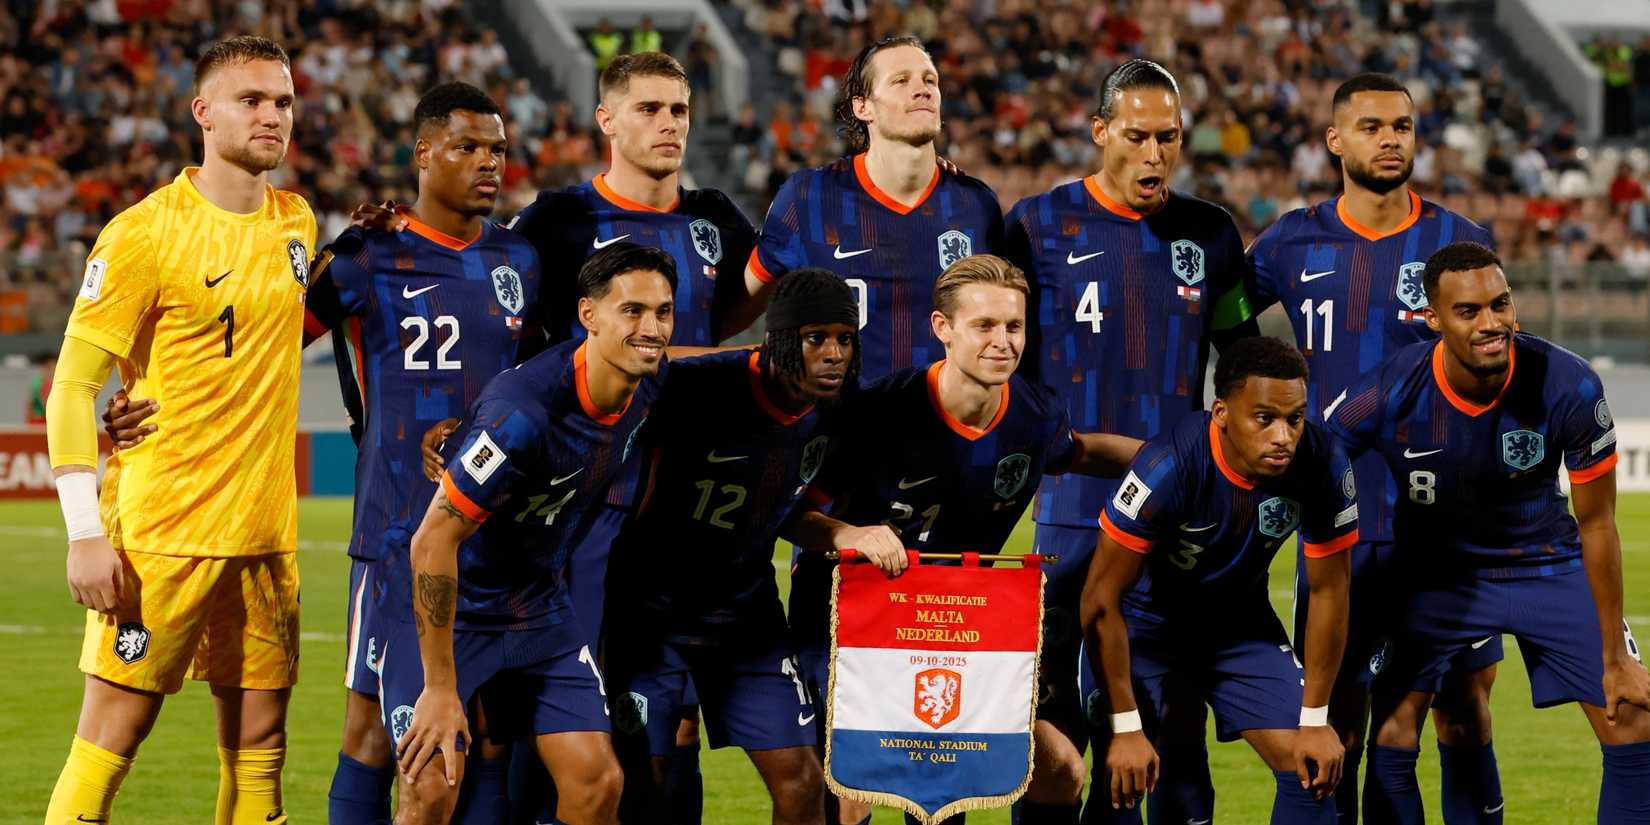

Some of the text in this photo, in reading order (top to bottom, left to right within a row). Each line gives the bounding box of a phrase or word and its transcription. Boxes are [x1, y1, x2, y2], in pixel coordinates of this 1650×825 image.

[1075, 281, 1104, 334] 4
[1300, 298, 1334, 352] 11
[218, 304, 234, 358] 1
[400, 315, 462, 371] 22
[692, 479, 748, 529] 12
[1408, 469, 1436, 505] 8
[512, 488, 577, 526] 14
[1169, 538, 1204, 572] 3
[888, 592, 908, 603] WK
[916, 594, 987, 606] KWALIFICATIE
[915, 610, 964, 624] MALTA
[895, 627, 980, 643] NEDERLAND
[910, 655, 967, 667] 09-10-2025
[880, 738, 988, 751] NATIONAL STADIUM
[929, 752, 957, 764] QALI
